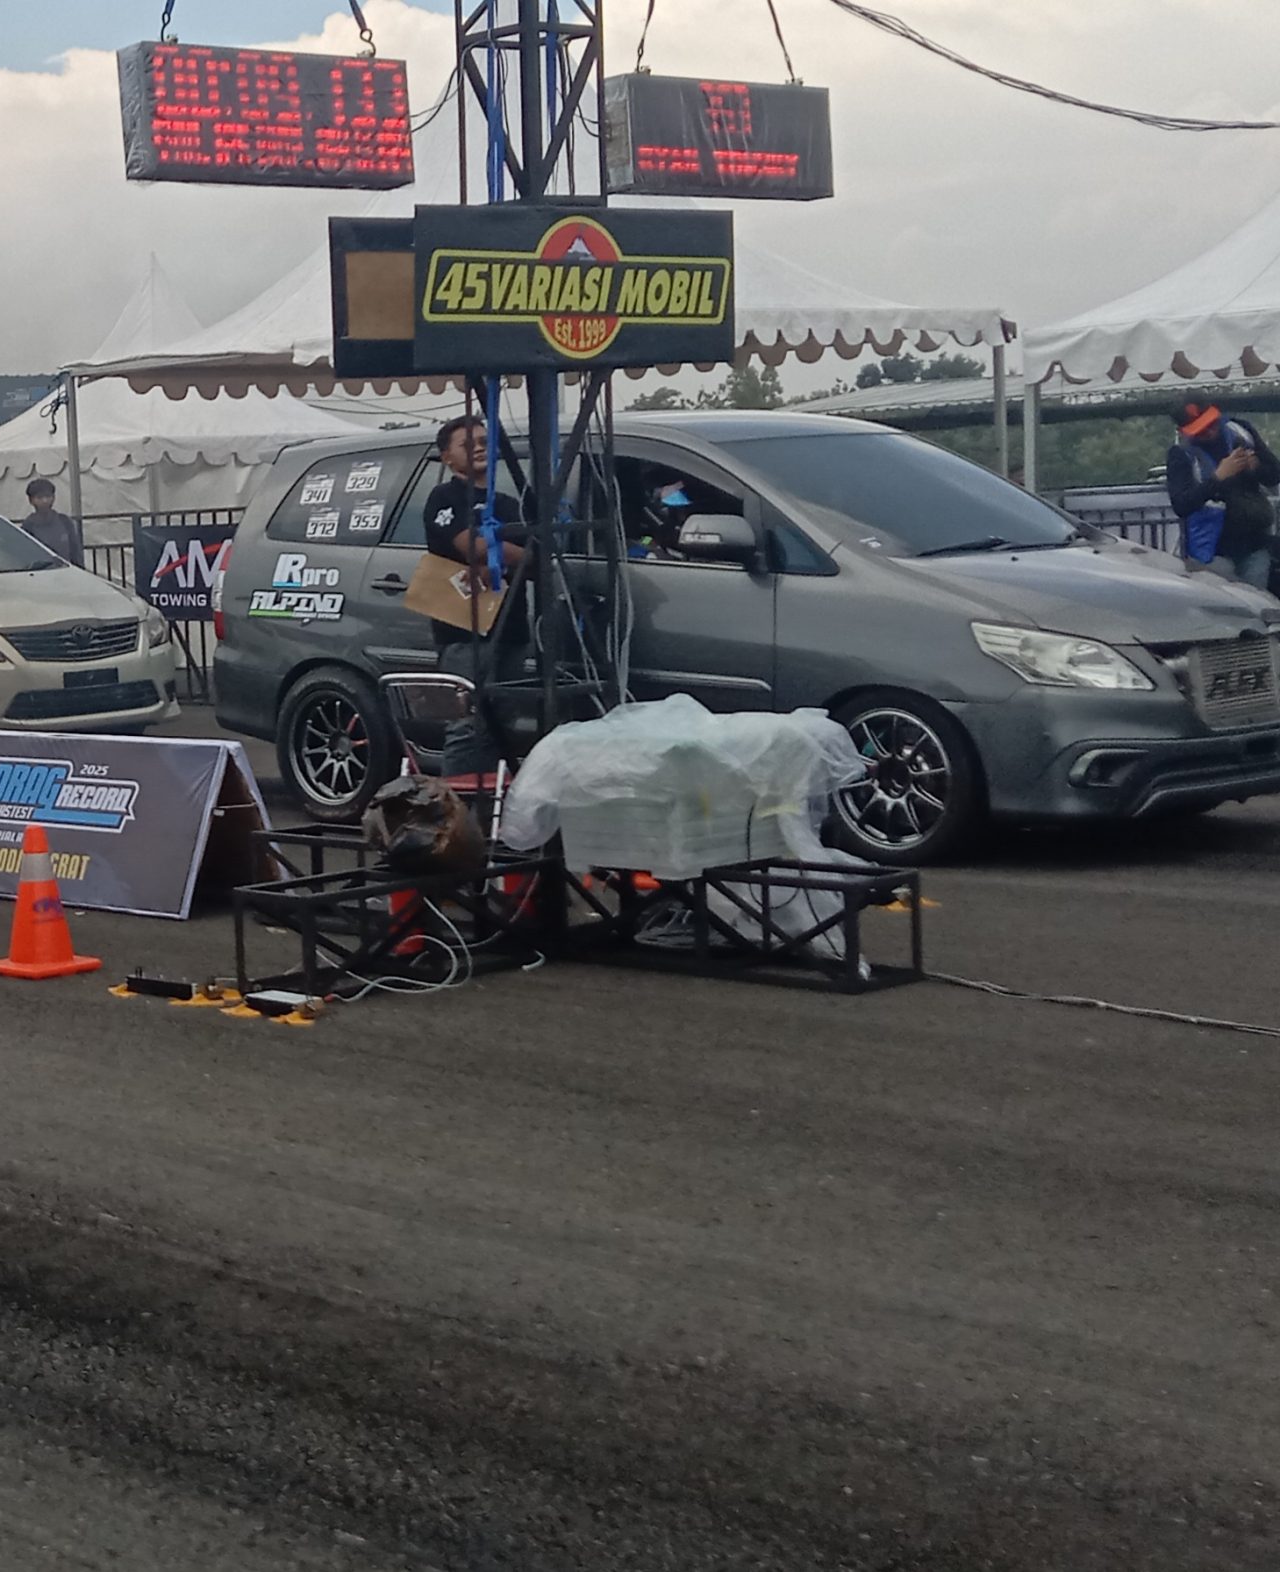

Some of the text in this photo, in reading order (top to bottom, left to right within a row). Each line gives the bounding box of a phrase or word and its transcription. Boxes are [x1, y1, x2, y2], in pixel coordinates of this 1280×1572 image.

[436, 261, 714, 315] 45VARIASI MOBIL
[579, 320, 607, 349] 1999
[347, 476, 377, 490] 329
[351, 514, 380, 528] 353
[150, 593, 208, 607] TOWING
[80, 764, 110, 776] 2025
[55, 784, 132, 812] RECORD
